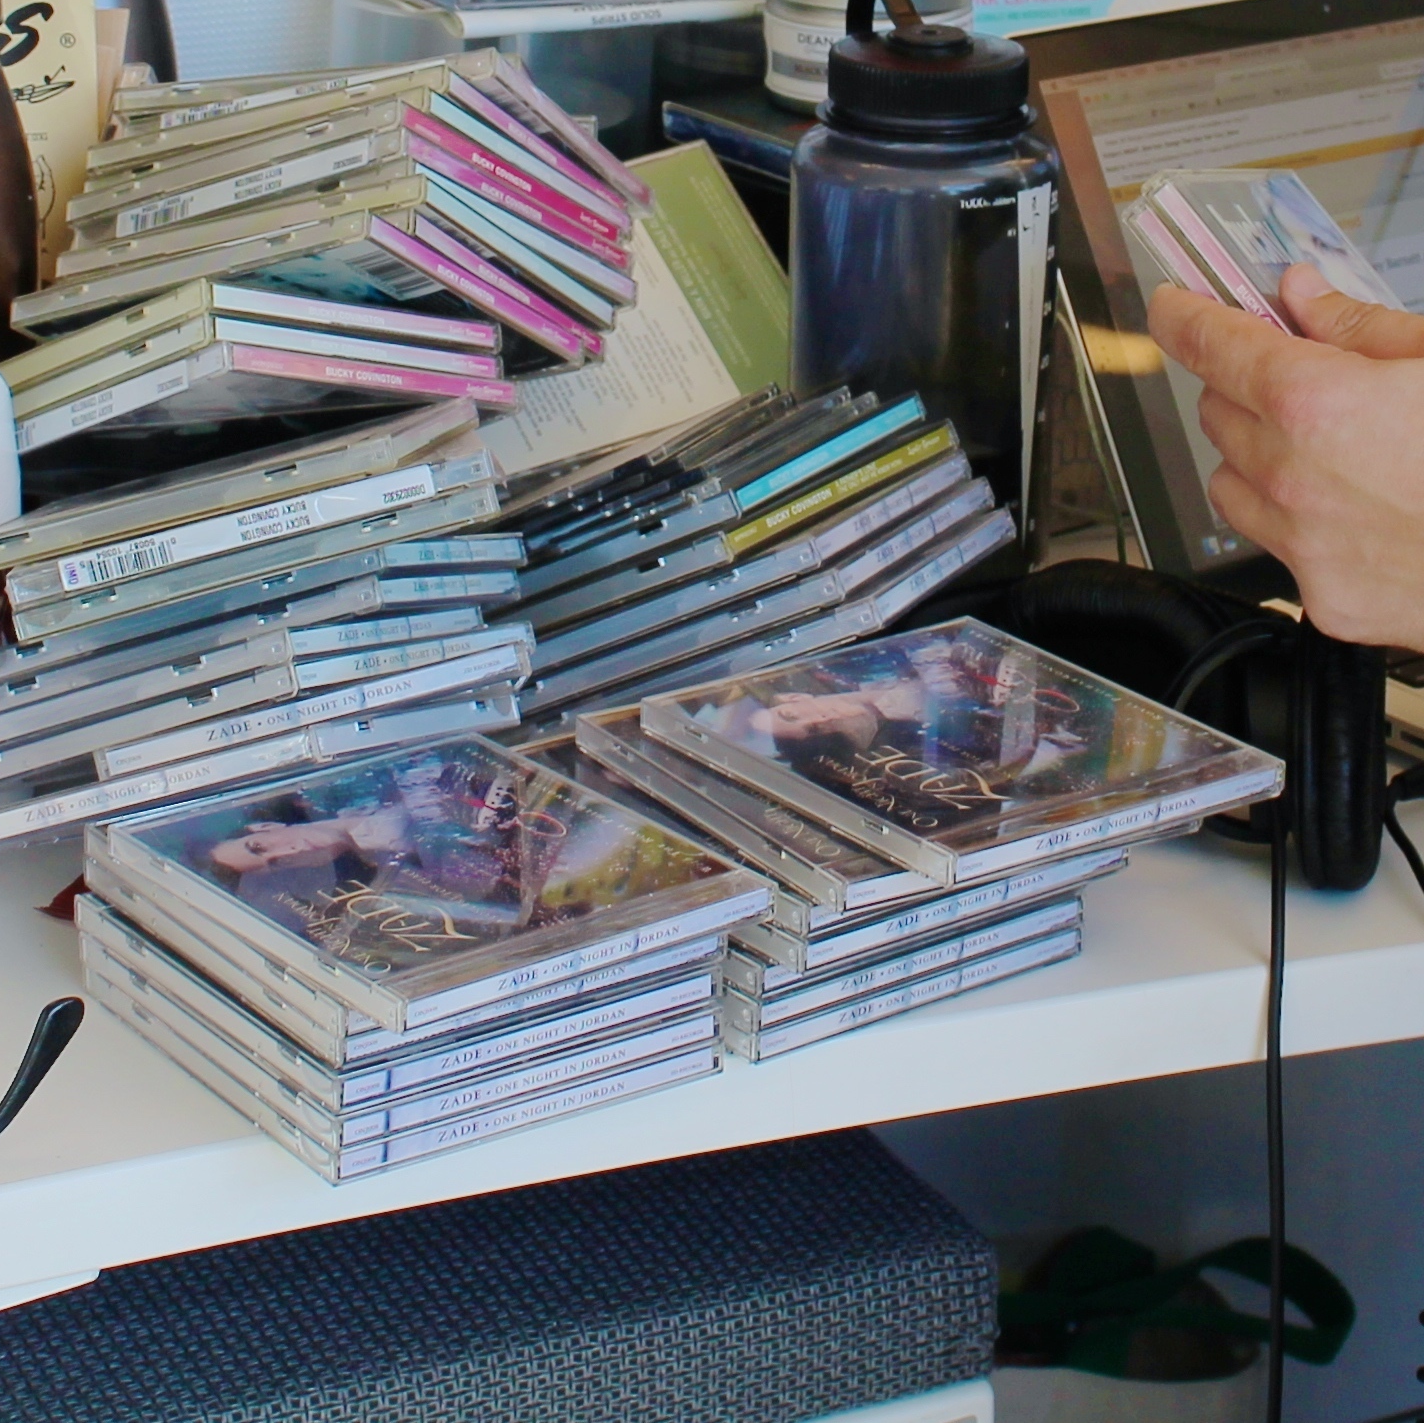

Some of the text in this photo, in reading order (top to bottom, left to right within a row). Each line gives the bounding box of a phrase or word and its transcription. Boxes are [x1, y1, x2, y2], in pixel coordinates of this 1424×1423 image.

[797, 32, 834, 46] DEAN
[472, 152, 532, 192] BUCKY COVINGTON
[325, 365, 404, 386] BUCKY COVINGTON
[236, 499, 307, 527] BUCKY COVINGTON
[241, 514, 311, 543] BUCKY COVINGTON
[766, 487, 833, 528] BUCKY COVINGTON
[354, 657, 382, 671] ZADE
[406, 649, 431, 663] NIGHT
[441, 641, 472, 661] JORDAN
[205, 720, 254, 742] ZADE
[266, 710, 292, 726] ONE
[296, 699, 339, 719] NIGHT
[342, 693, 358, 706] IN
[359, 679, 414, 708] JORDAN
[25, 802, 67, 823] ZADE
[78, 794, 102, 808] ONE
[106, 783, 143, 802] NIGHT
[161, 765, 212, 792] JORDAN
[1035, 795, 1198, 851] ZADE ONE NIGHT IN JORDAN
[885, 872, 1046, 934] ZADE ONE NIGHT IN JORDAN
[497, 968, 539, 992] ZADE
[551, 956, 578, 976] ONE
[579, 945, 617, 966] NIGHT
[619, 939, 633, 954] IN
[634, 925, 681, 954] JORDAN
[577, 965, 627, 992] JORDAN
[840, 930, 1001, 992] ZADE ONE NIGHT IN JORDAN
[838, 962, 999, 1025] ZADE ONE NIGHT IN JORDAN
[441, 1048, 483, 1069] ZADE
[495, 1037, 520, 1054] ONE
[522, 1027, 560, 1048] NIGHT
[563, 1020, 577, 1033] IN
[579, 1006, 627, 1031] JORDAN
[440, 1089, 482, 1111] ZADE
[494, 1078, 519, 1096] ONE
[522, 1069, 560, 1089] NIGHT
[563, 1062, 577, 1075] IN
[579, 1048, 627, 1073] JORDAN
[438, 1121, 481, 1143] ZADE
[492, 1111, 518, 1128] ONE
[520, 1101, 559, 1121] NIGHT
[562, 1094, 576, 1108] IN
[578, 1081, 626, 1104] JORDAN
